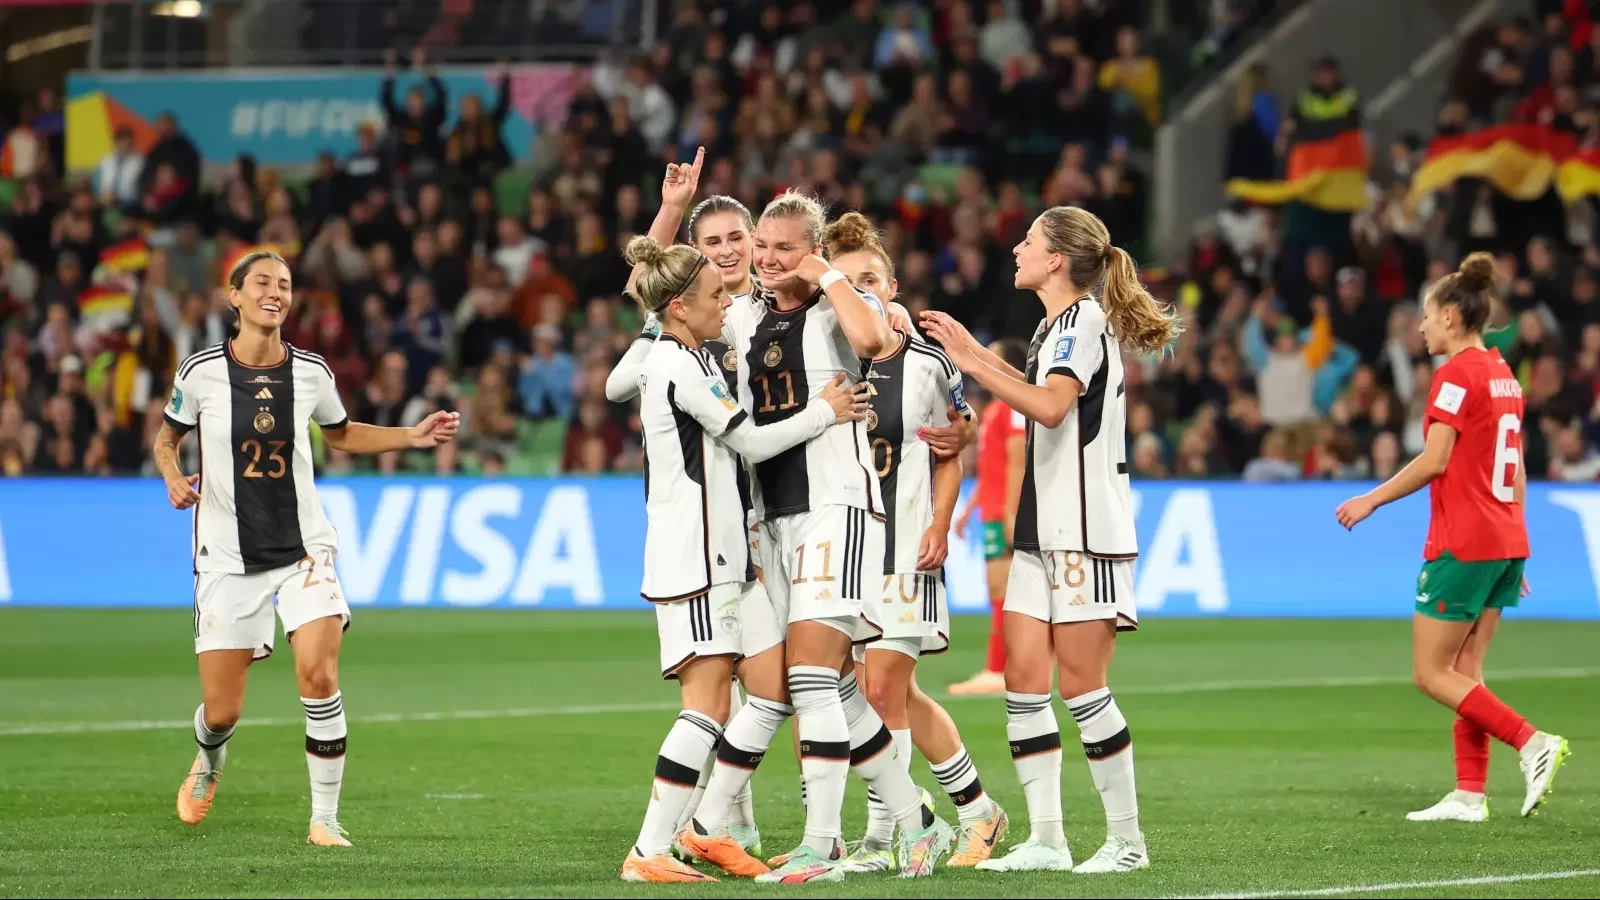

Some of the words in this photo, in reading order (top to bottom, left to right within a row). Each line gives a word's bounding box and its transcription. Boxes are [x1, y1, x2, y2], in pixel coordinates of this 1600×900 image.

[753, 369, 799, 412] 11
[240, 439, 287, 478] 23
[871, 438, 892, 477] 0
[1491, 413, 1520, 503] 6
[314, 482, 605, 606] VISA
[792, 540, 836, 585] 11
[297, 549, 336, 588] 23
[1048, 550, 1086, 590] 18
[317, 743, 343, 752] DFB
